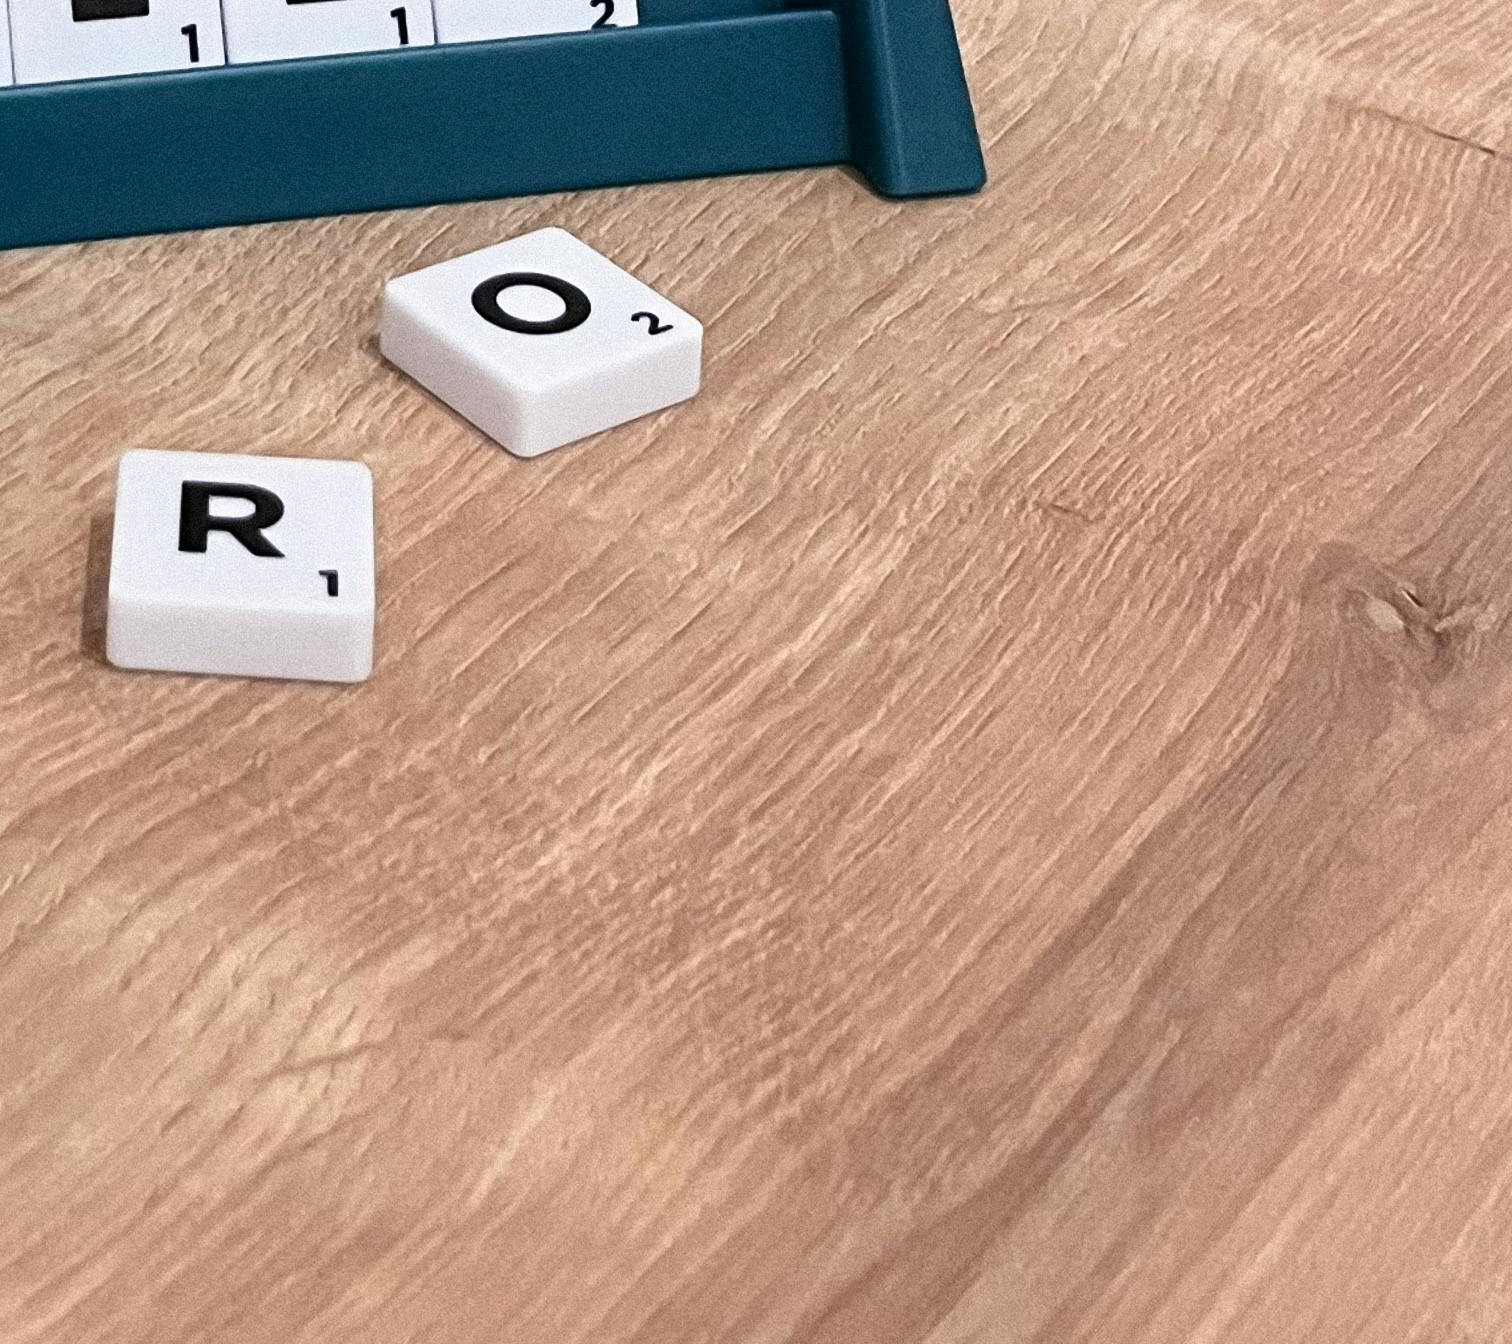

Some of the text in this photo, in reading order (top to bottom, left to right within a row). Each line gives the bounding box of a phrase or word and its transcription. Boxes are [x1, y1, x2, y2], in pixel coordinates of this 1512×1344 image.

[180, 23, 201, 63] 1
[390, 6, 410, 46] 1
[470, 271, 674, 337] O 2
[177, 479, 340, 598] R 1
